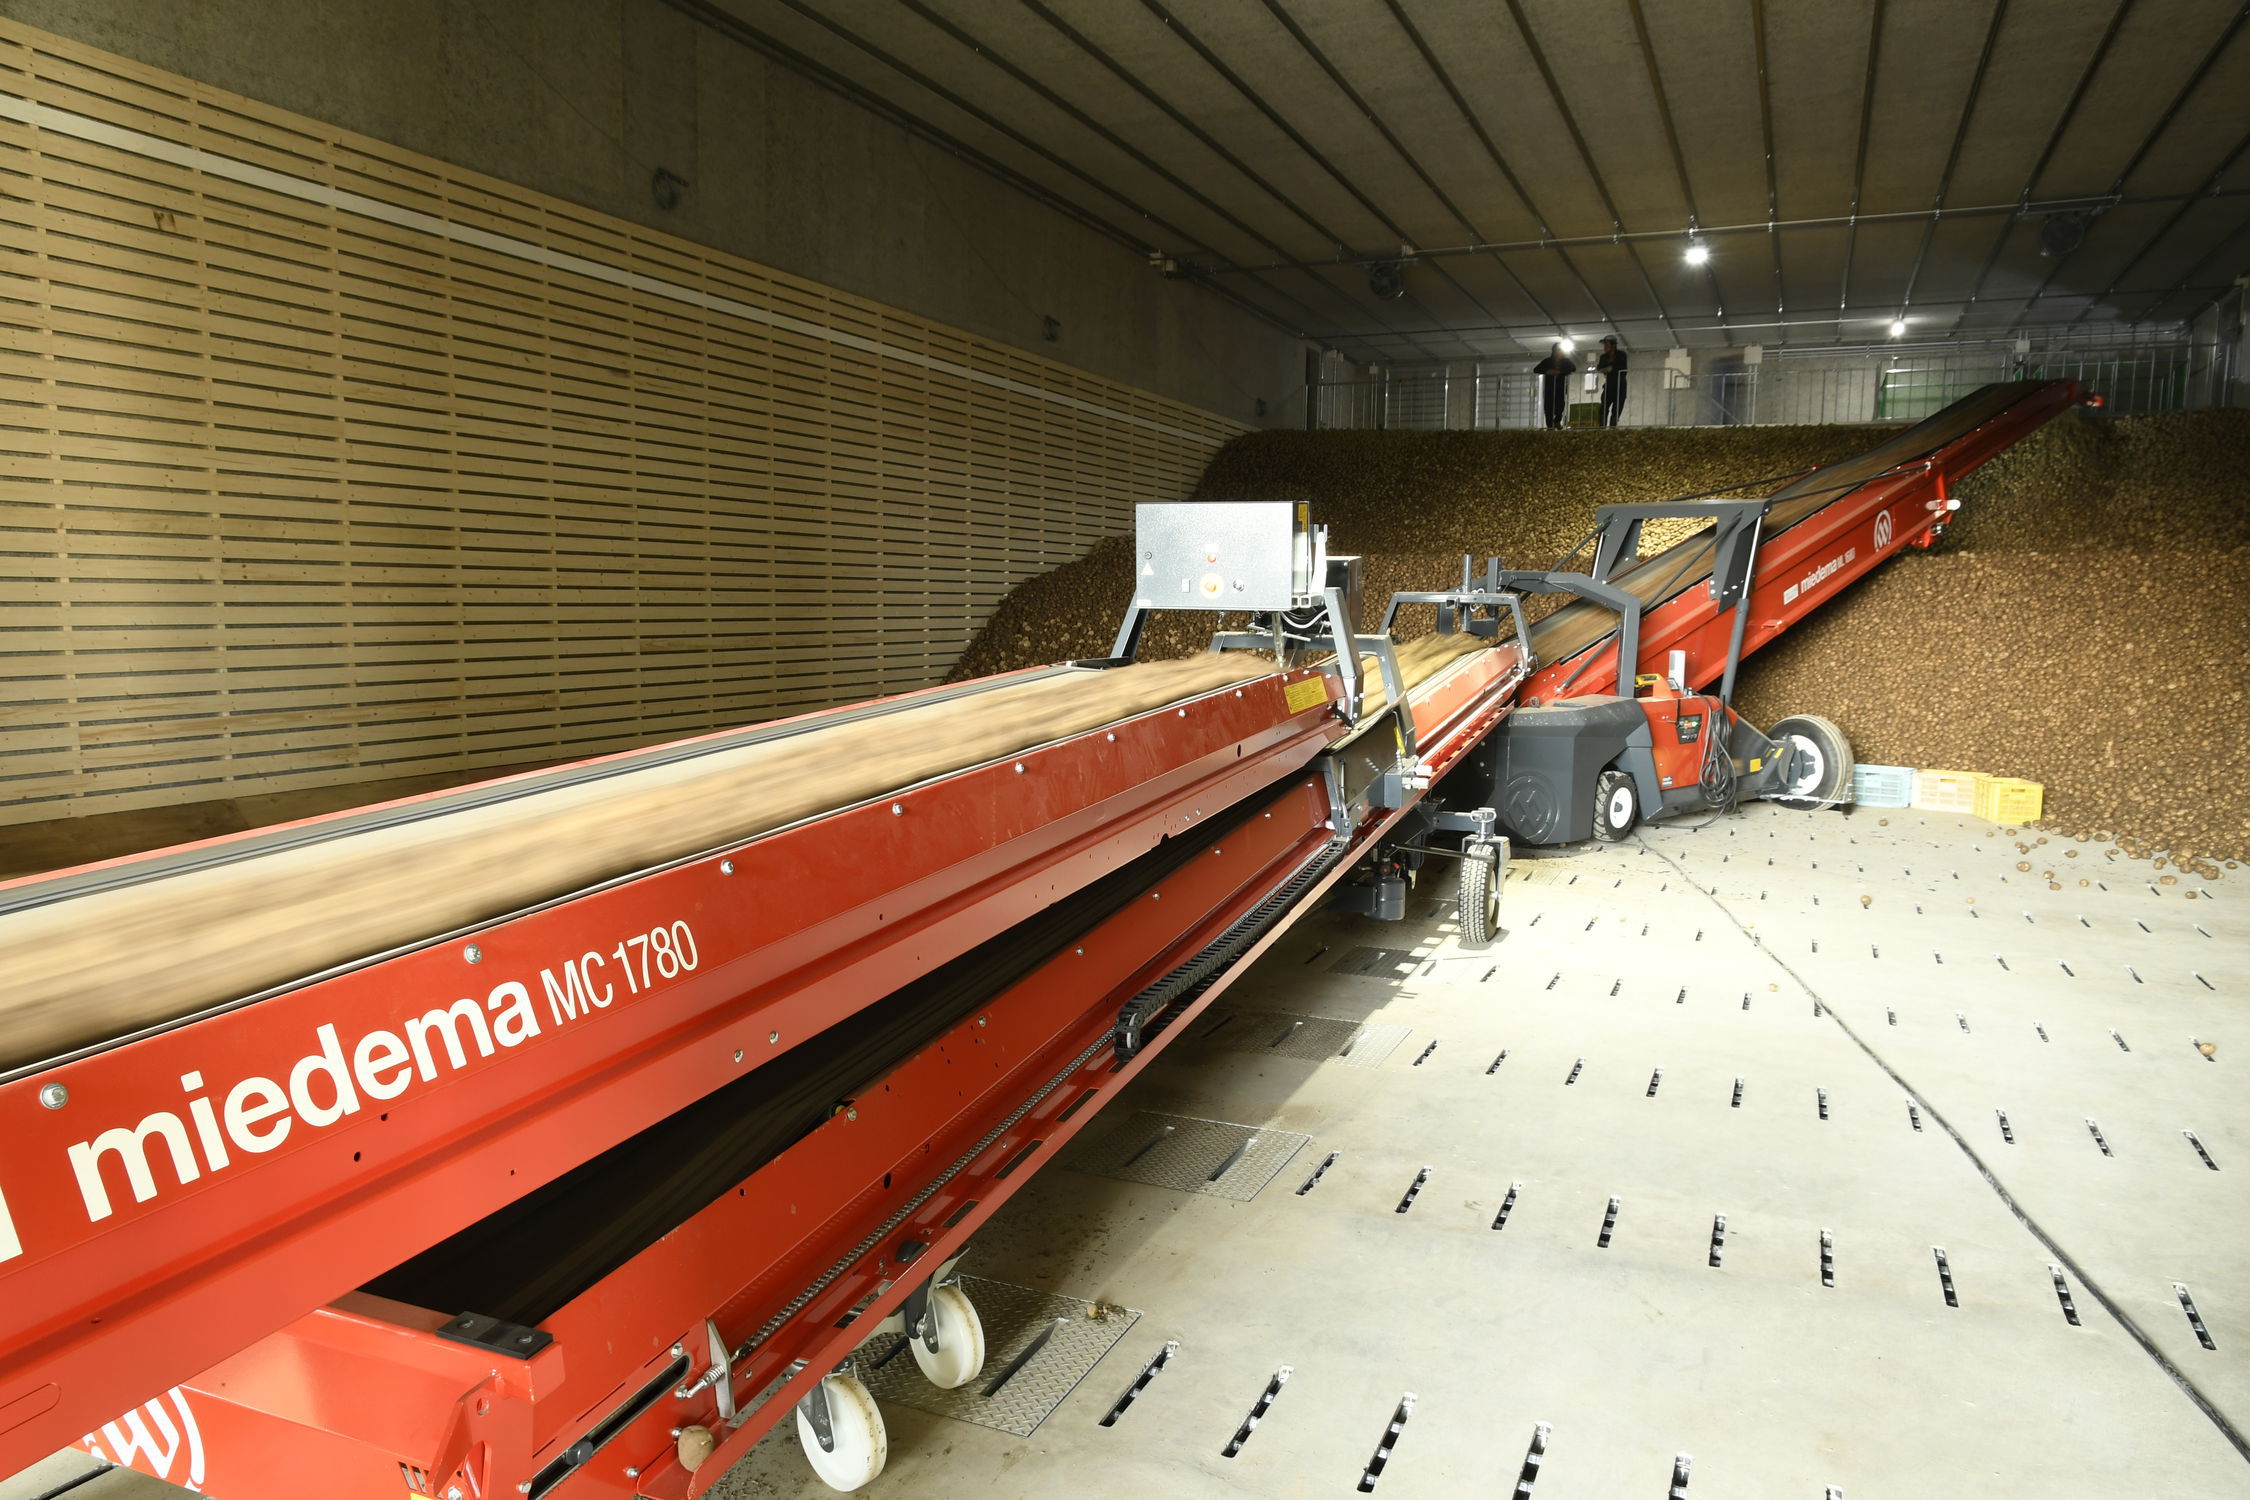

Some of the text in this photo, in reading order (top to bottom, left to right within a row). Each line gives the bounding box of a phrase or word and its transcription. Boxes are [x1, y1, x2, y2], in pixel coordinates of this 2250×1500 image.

[1801, 558, 1837, 594] miedema
[68, 920, 698, 1222] miedema MC 1780
